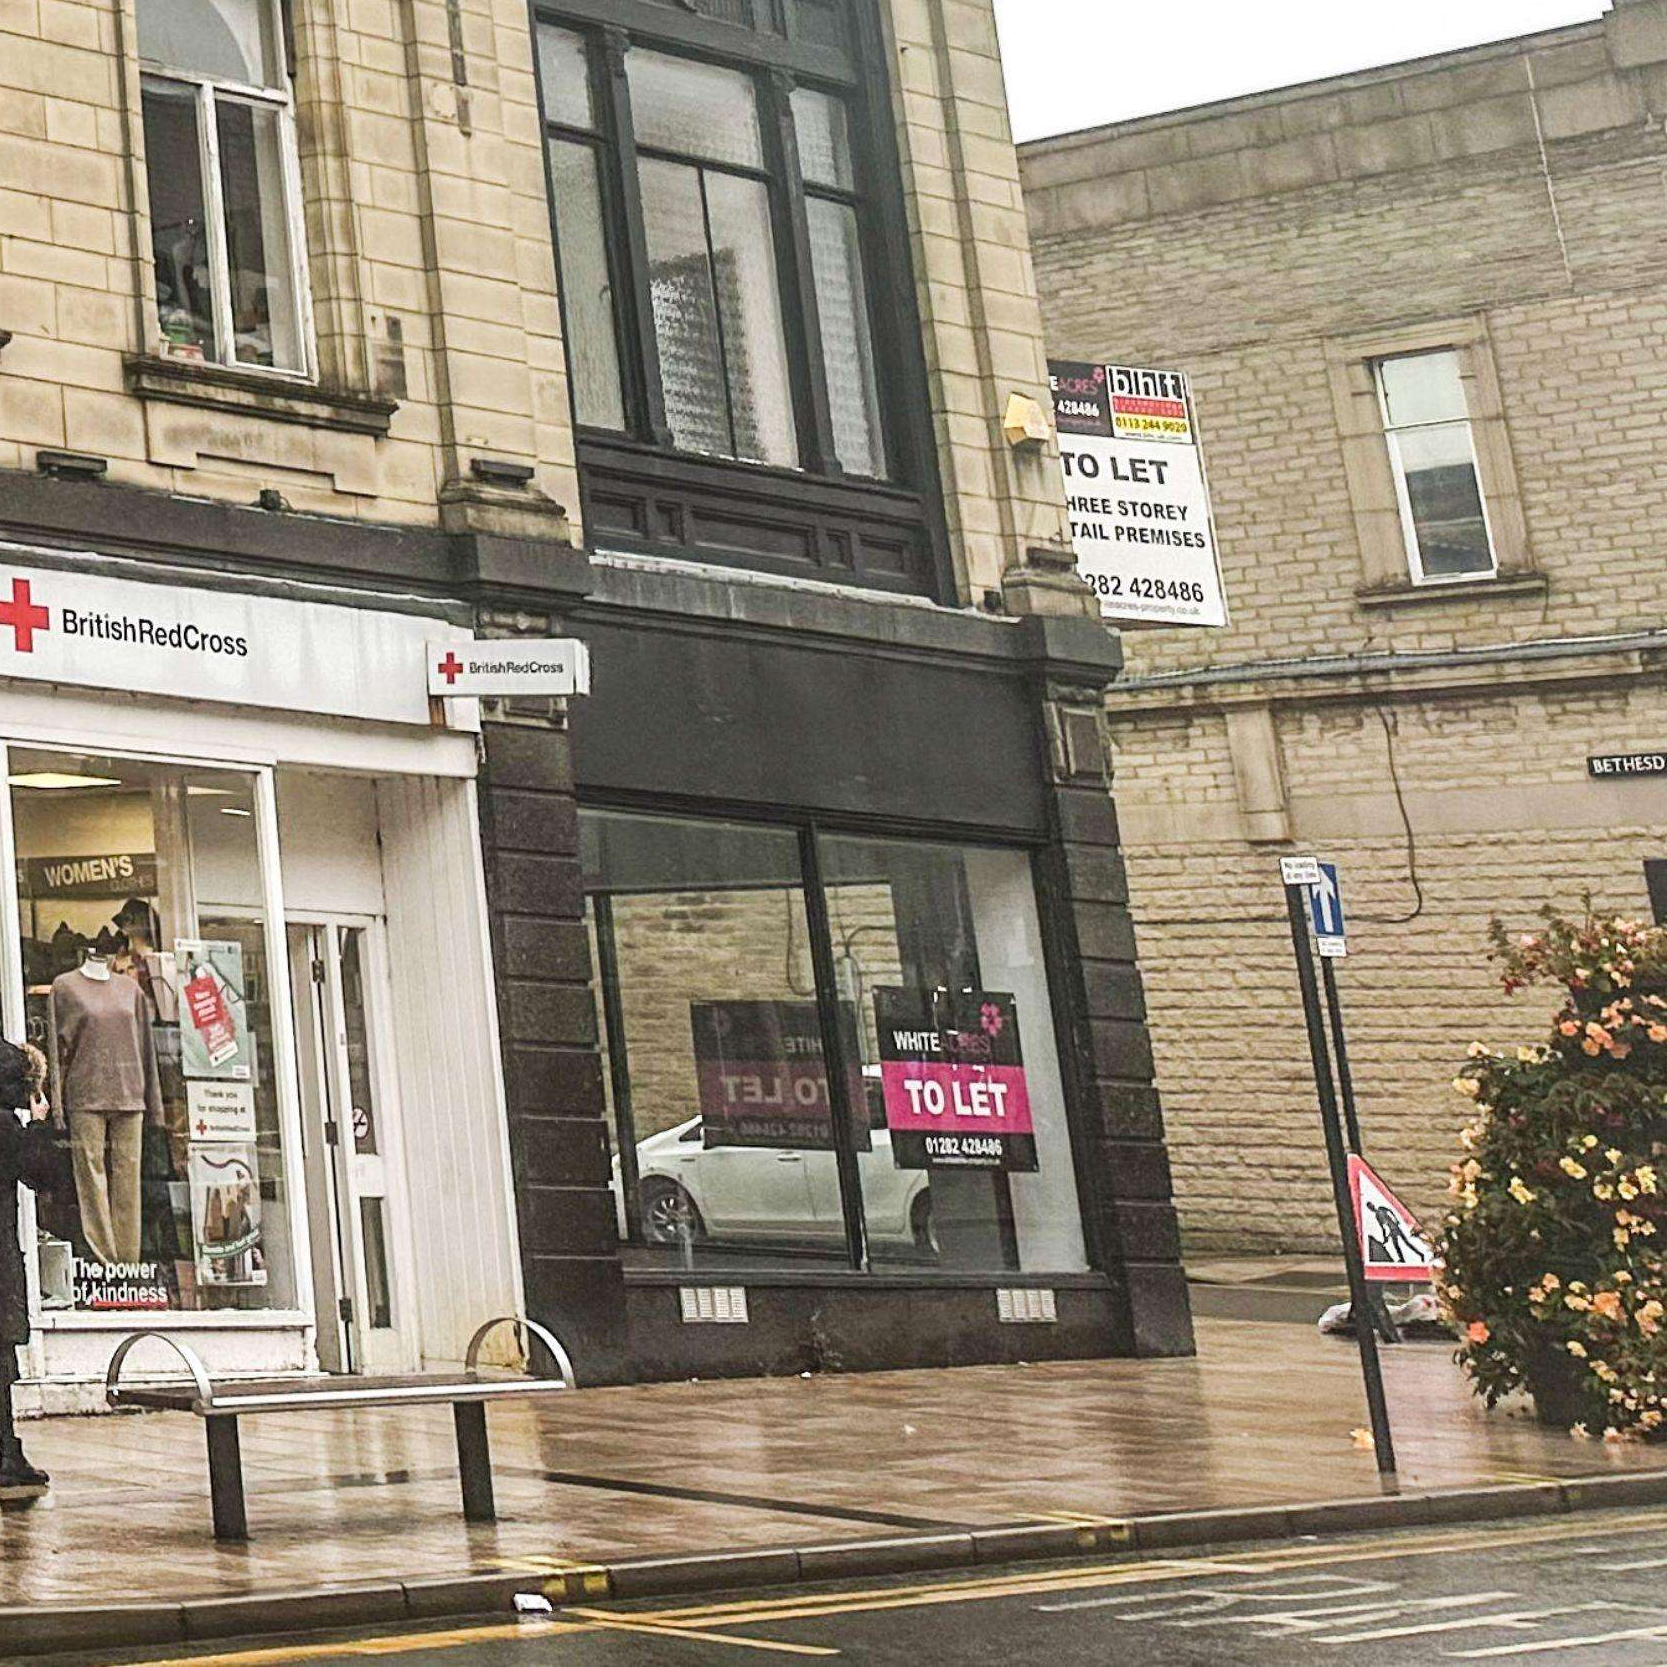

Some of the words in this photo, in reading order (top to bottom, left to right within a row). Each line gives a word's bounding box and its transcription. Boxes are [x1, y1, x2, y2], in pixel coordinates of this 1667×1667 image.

[1060, 451, 1099, 479] TO
[1110, 456, 1169, 485] LET
[1067, 497, 1113, 515] HREE
[1117, 500, 1189, 522] STOREY
[1070, 522, 1110, 541] TAIL
[1115, 526, 1206, 549] PREMISES
[1129, 577, 1205, 603] 428486
[62, 608, 249, 657] BritishRedCross
[469, 661, 564, 674] BritishRedCross
[44, 855, 134, 887] WOMEN'S
[904, 1079, 945, 1115] TO
[952, 1079, 1008, 1117] LET
[72, 1258, 103, 1278] The
[106, 1262, 157, 1282] power
[72, 1281, 88, 1302] of
[92, 1281, 168, 1303] kindness
